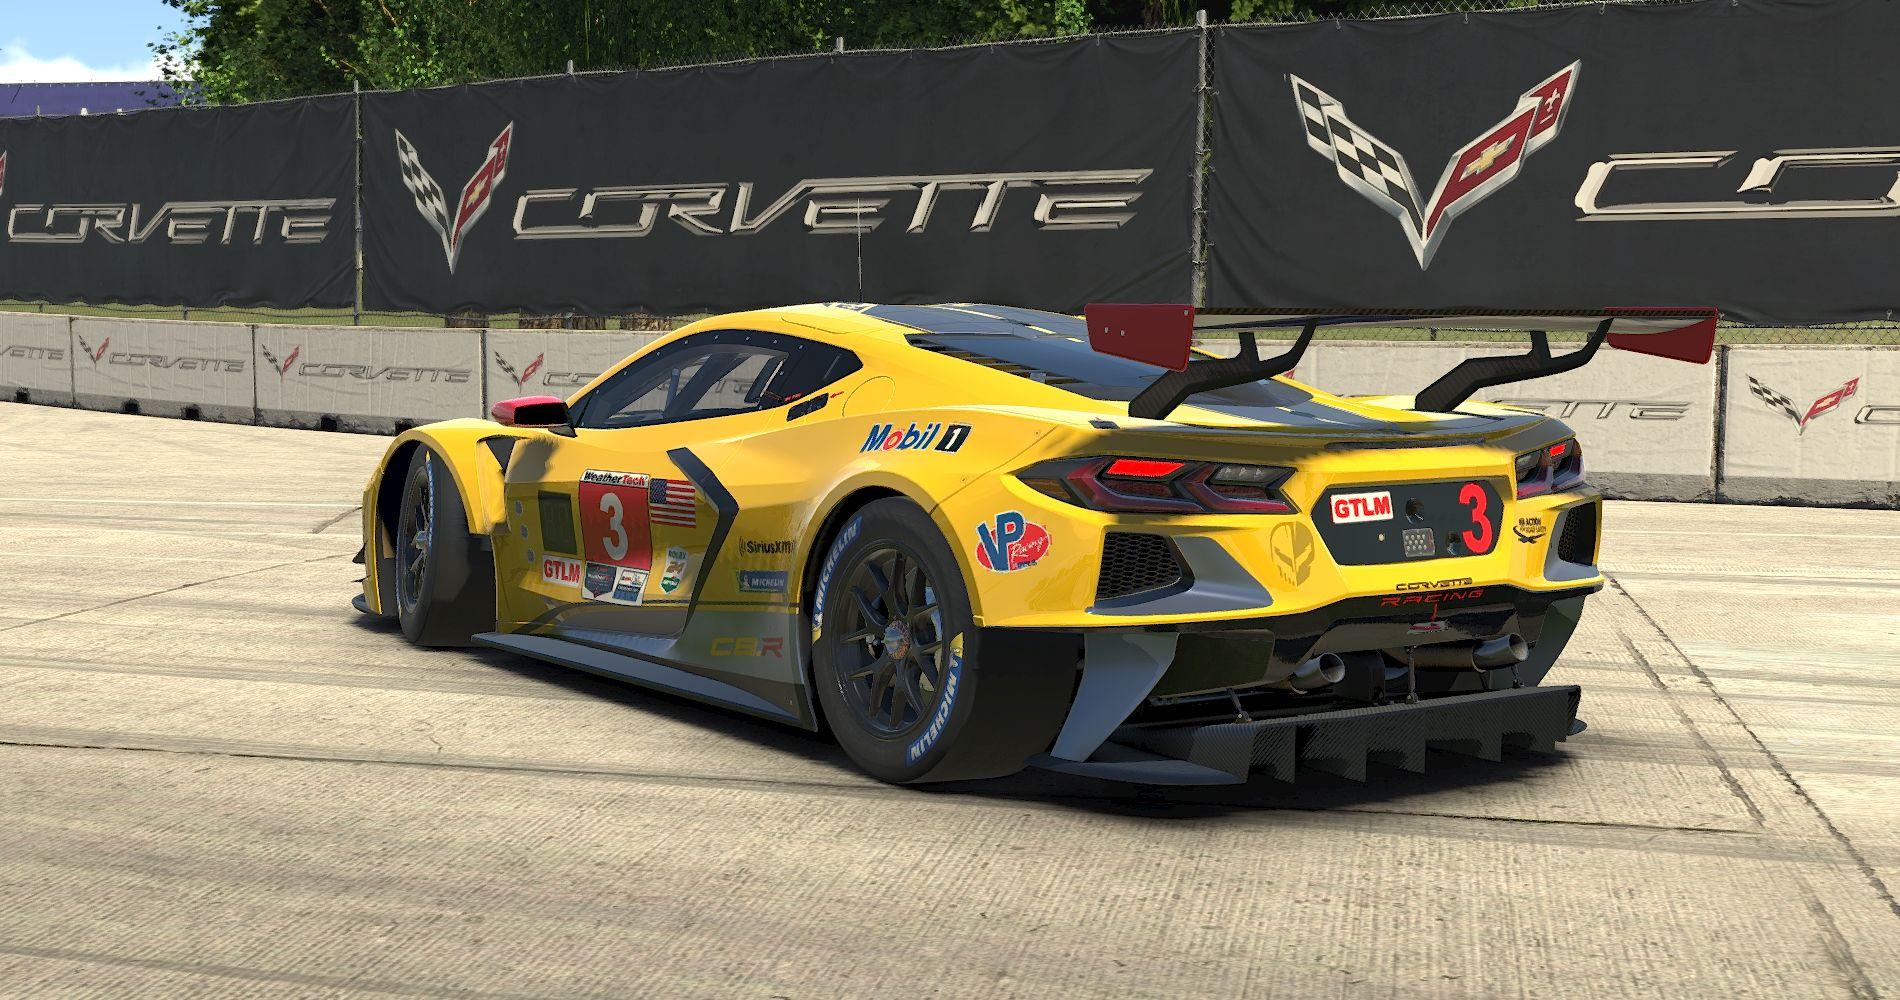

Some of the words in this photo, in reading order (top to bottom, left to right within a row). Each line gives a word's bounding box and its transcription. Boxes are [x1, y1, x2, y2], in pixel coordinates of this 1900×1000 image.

[513, 168, 1154, 240] CORVETTE
[7, 197, 336, 245] CORVETTE
[108, 351, 247, 372] CORVETTE
[298, 362, 472, 383] CORVETTE
[860, 421, 942, 453] Mobil
[584, 471, 648, 487] WeatherTech
[1334, 495, 1392, 519] GTLM
[1459, 483, 1493, 553] 3
[600, 492, 629, 561] 3
[976, 510, 1026, 572] VP
[544, 559, 581, 584] GTLM
[814, 521, 858, 610] MICHELIN
[751, 578, 785, 587] MICHELIN
[1395, 577, 1472, 591] CORVETTE
[1380, 589, 1485, 609] RACING
[910, 671, 958, 762] MICHELIN
